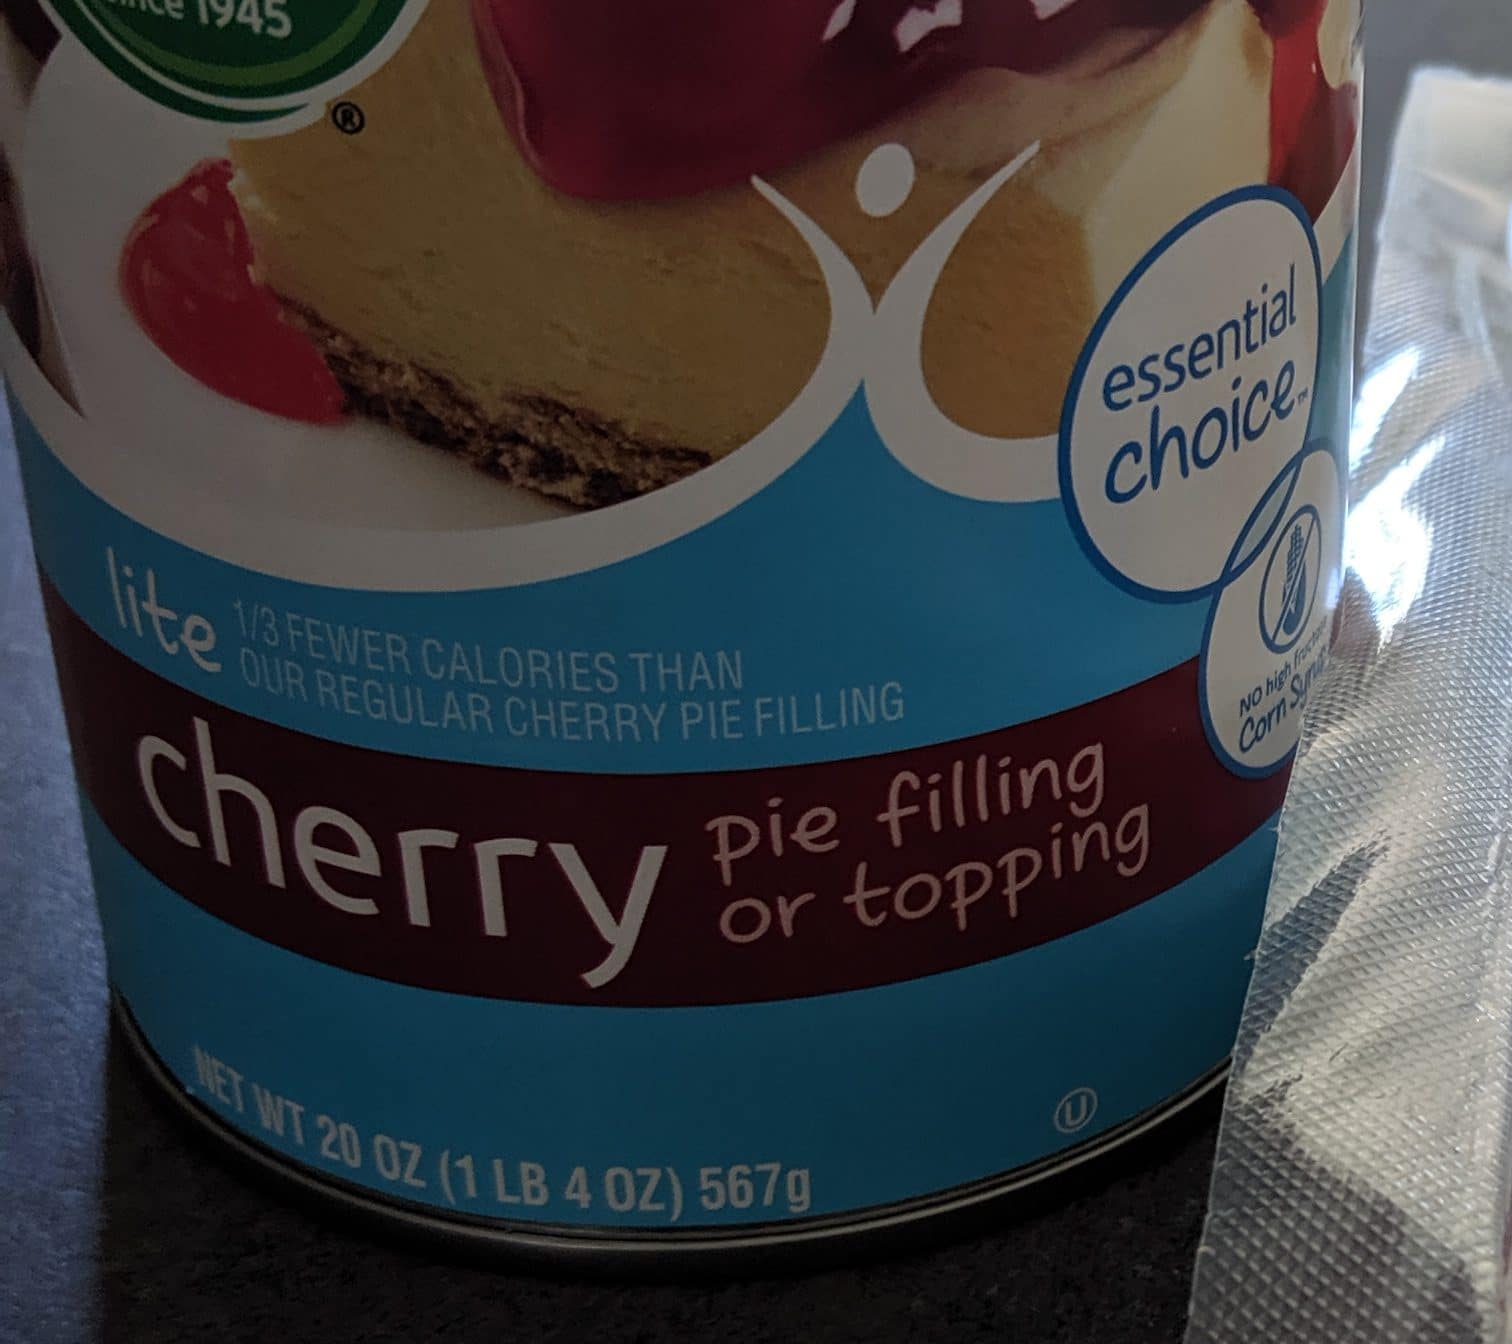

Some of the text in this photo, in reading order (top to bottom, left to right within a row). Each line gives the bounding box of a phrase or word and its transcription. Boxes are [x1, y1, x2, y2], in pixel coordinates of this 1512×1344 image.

[1102, 262, 1297, 412] essential
[106, 546, 222, 673] lite
[233, 598, 743, 695] 1/3 FEWER CALORIES THAN
[240, 647, 906, 743] OUR REGULAR CHERRY PIE FILLING
[1239, 697, 1287, 754] Corn
[136, 715, 669, 990] cherry
[704, 740, 1106, 887] pie filling
[719, 801, 1152, 945] or topping
[193, 1044, 813, 1222] NET WT 20 OZ (1 LB 4 OZ) 567g
